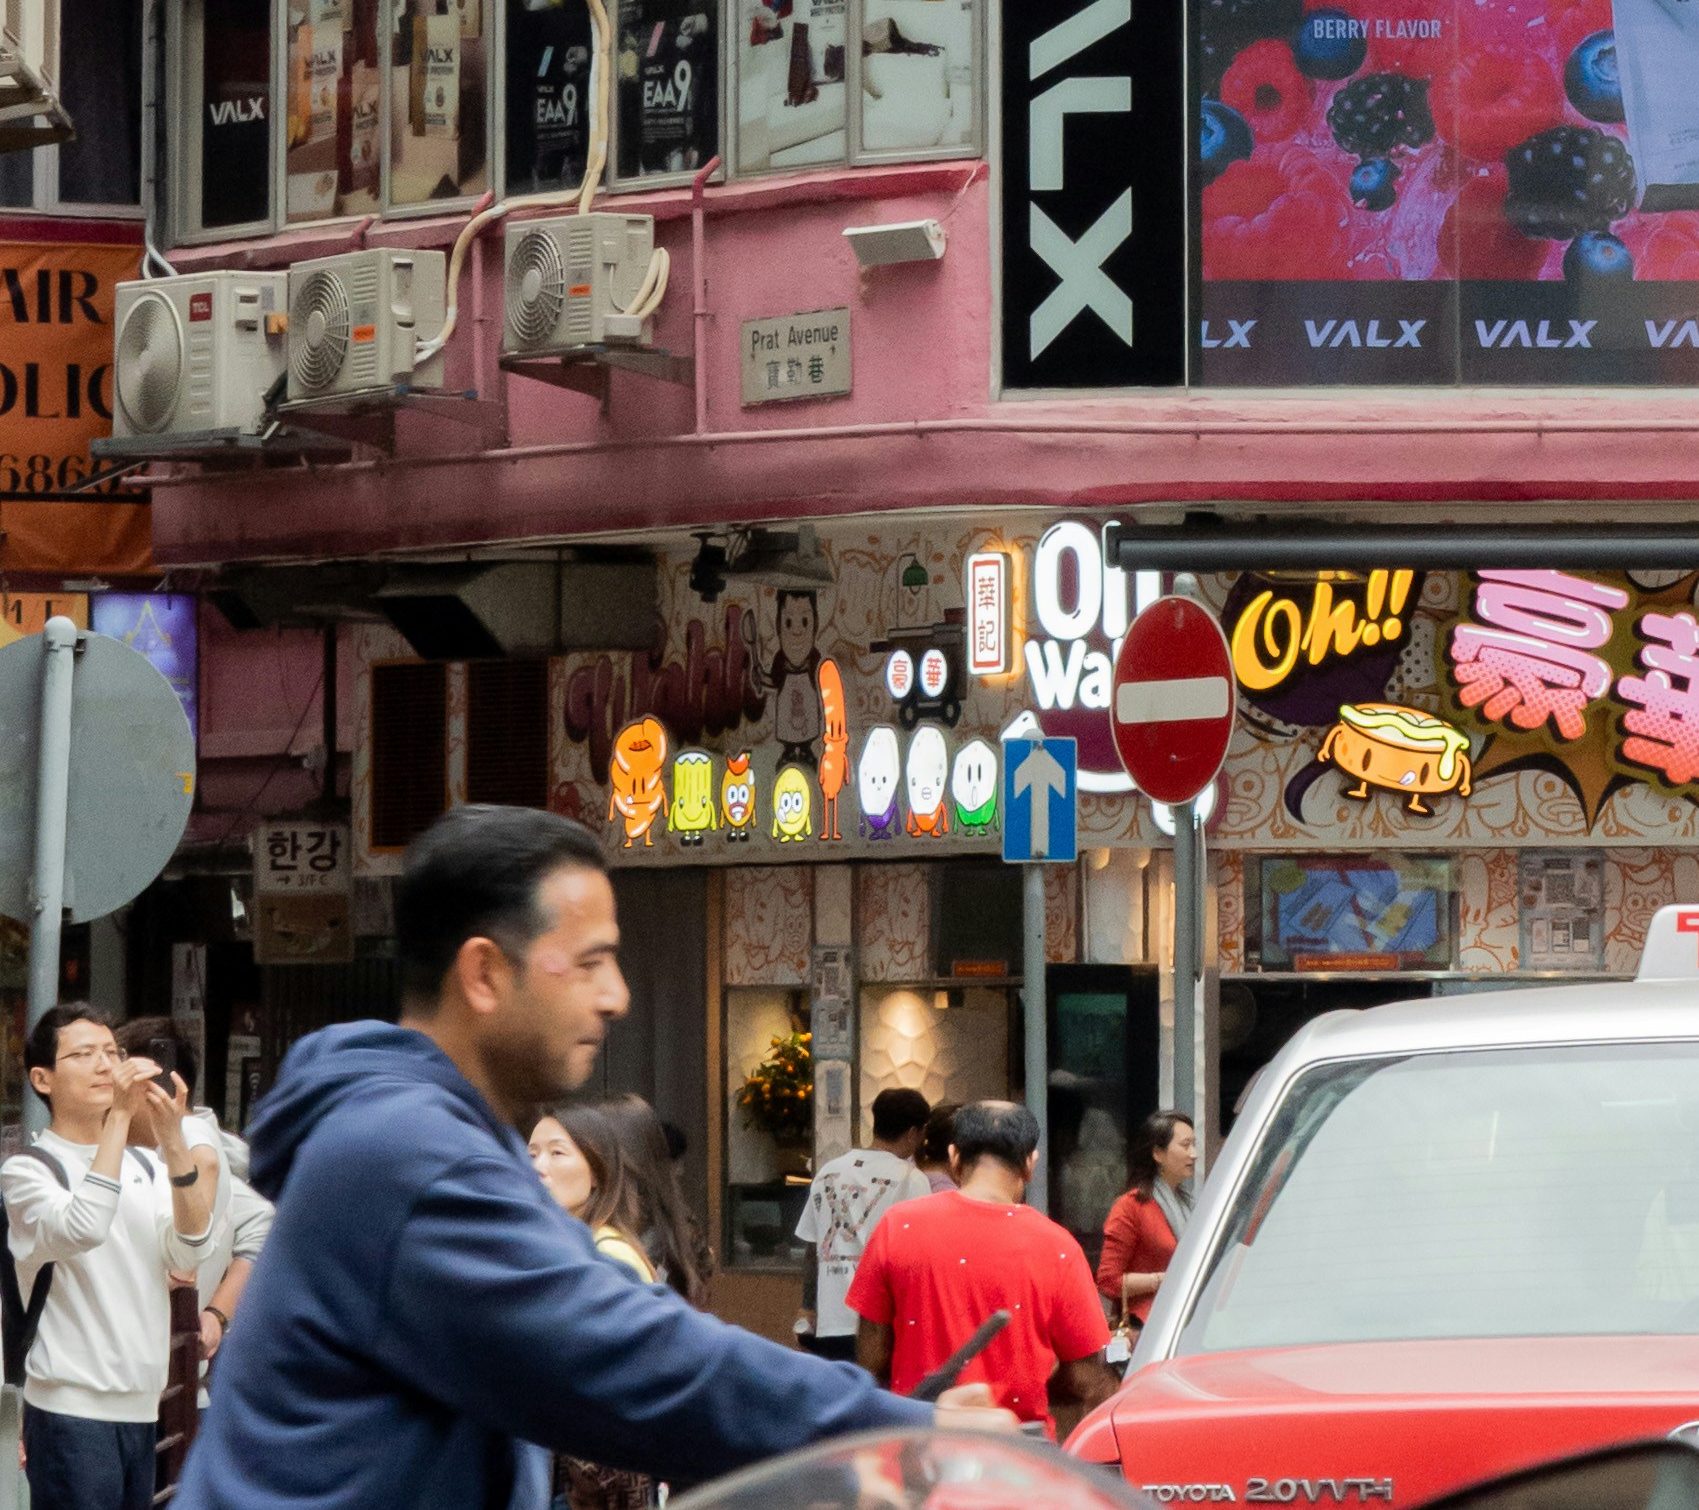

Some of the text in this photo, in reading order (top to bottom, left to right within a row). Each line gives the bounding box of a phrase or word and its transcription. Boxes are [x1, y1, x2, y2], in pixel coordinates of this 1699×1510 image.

[1313, 19, 1441, 39] BERRY FLAVOR
[643, 59, 692, 112] EAA9
[209, 96, 265, 126] VALX
[536, 83, 577, 126] EAA9
[752, 325, 838, 350] Prat Avenue
[1201, 320, 1257, 348] LX
[1304, 320, 1427, 348] VALX
[1474, 320, 1598, 348] VALX
[978, 575, 997, 653] 華記
[1024, 637, 1124, 711] Wa
[266, 829, 342, 873] 한강
[1142, 1483, 1236, 1502] TOYOTA
